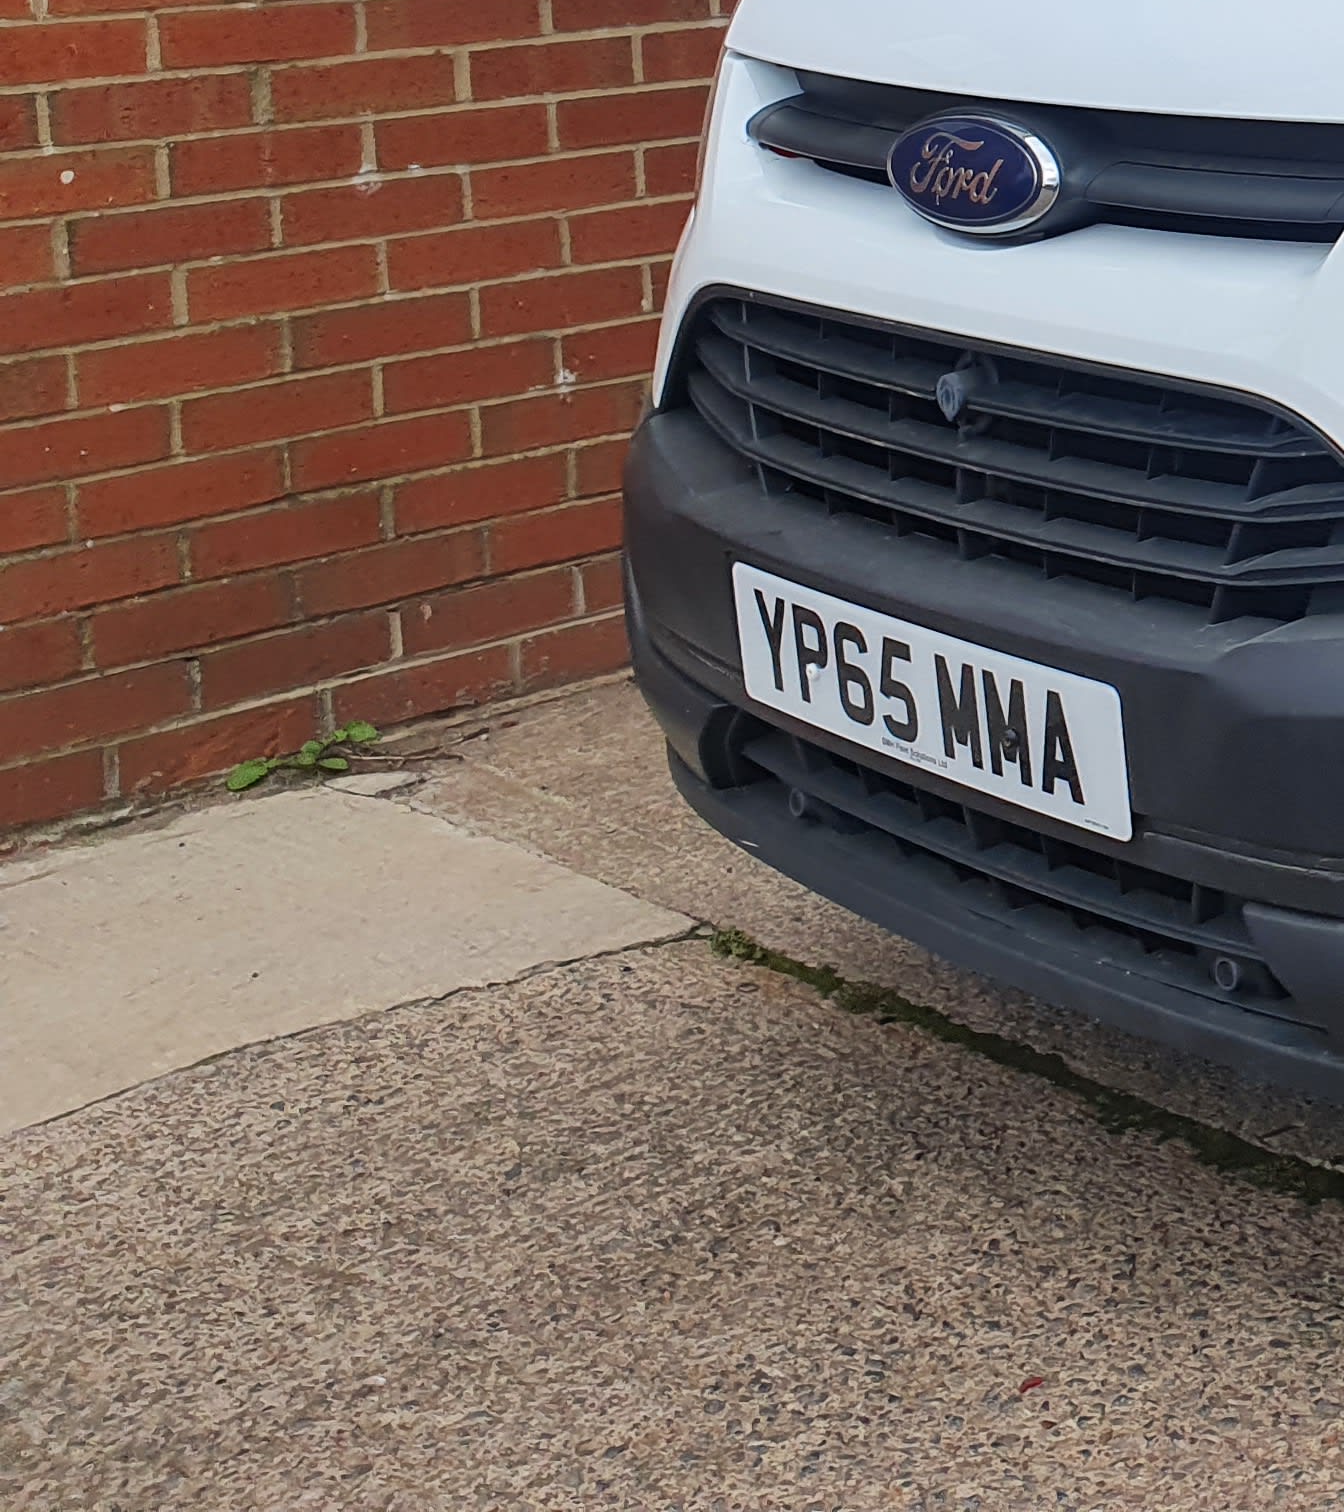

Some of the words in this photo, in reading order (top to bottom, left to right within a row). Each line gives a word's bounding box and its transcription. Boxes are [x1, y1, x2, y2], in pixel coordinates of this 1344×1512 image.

[911, 131, 1004, 206] Ford
[754, 589, 919, 743] YP65
[934, 653, 1086, 806] MMA
